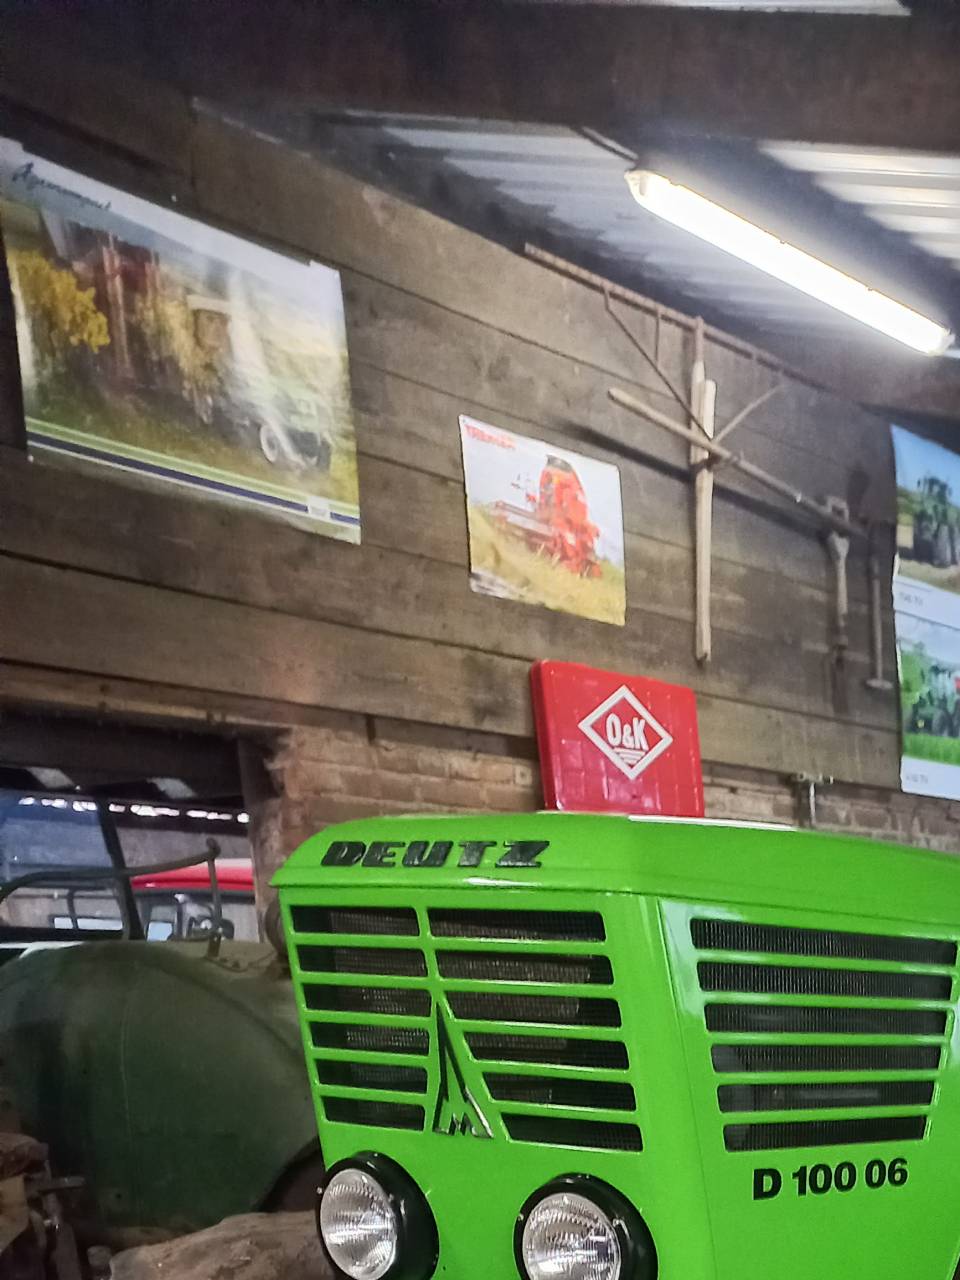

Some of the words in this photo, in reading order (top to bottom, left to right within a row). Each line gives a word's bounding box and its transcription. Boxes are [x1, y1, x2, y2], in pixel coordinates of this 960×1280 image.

[605, 713, 649, 752] O&K
[320, 840, 550, 868] DEUTZ
[753, 1168, 782, 1200] D
[792, 1161, 857, 1196] 100
[865, 1157, 909, 1189] 06
